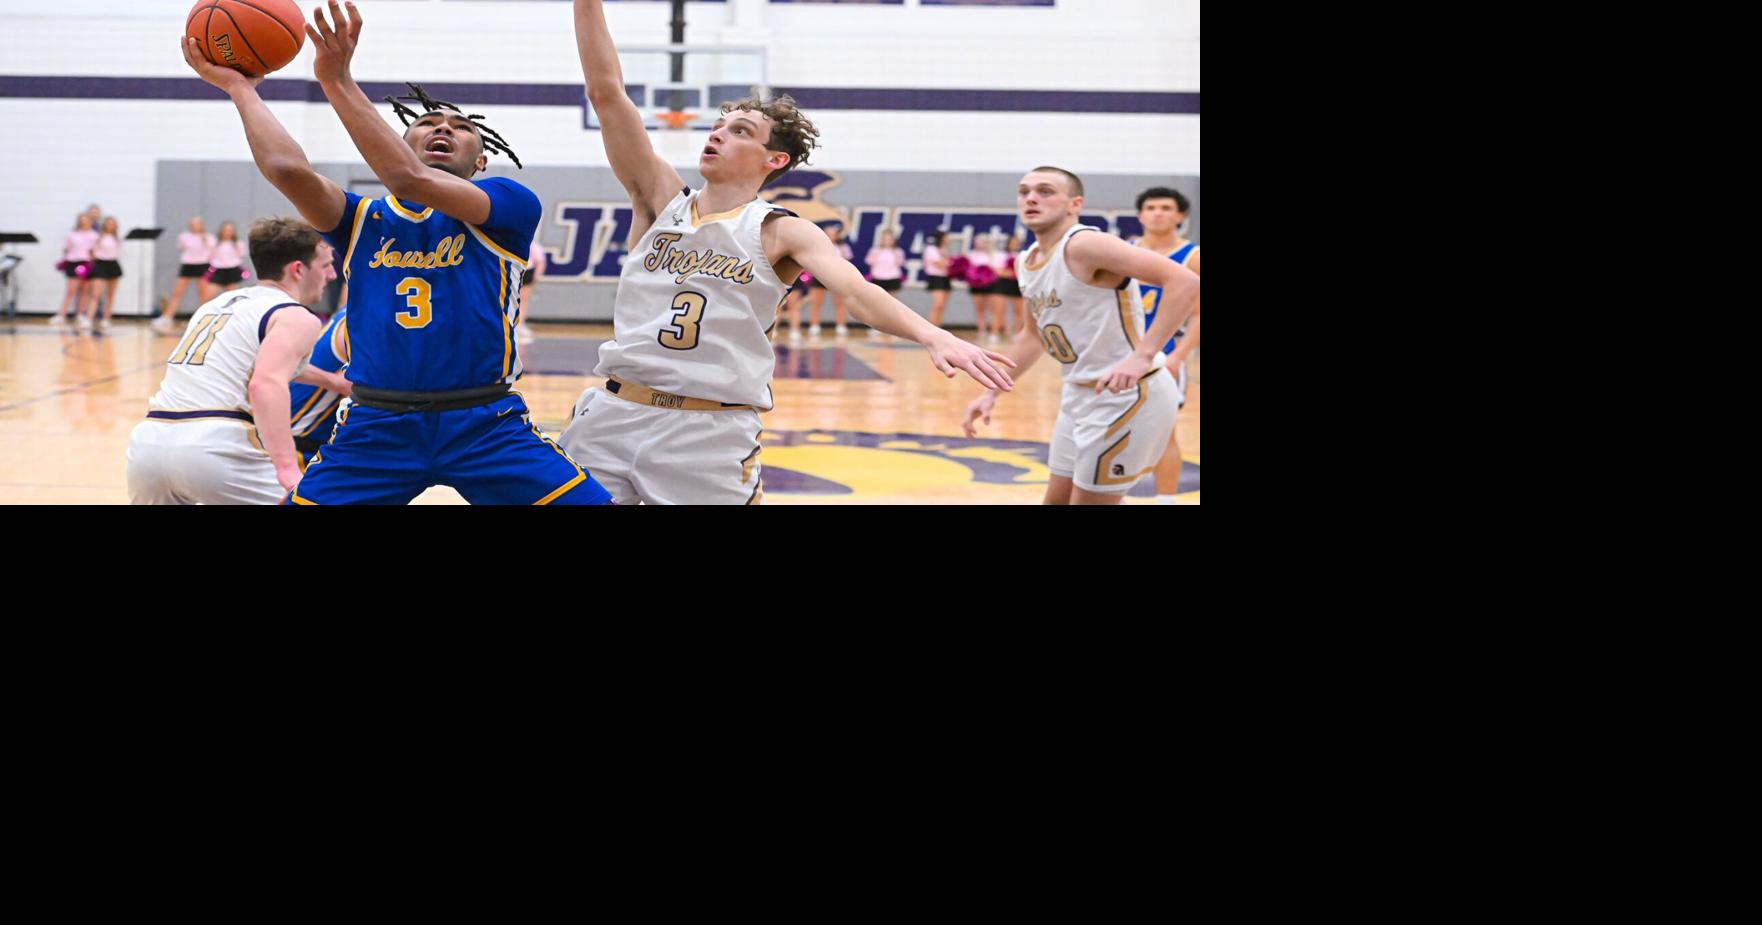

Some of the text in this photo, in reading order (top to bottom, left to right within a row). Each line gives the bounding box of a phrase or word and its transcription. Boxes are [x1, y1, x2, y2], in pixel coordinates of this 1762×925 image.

[644, 232, 754, 284] Trojans
[395, 276, 432, 329] 3
[657, 291, 707, 350] 3
[167, 313, 233, 366] 11
[651, 392, 686, 409] TROY
